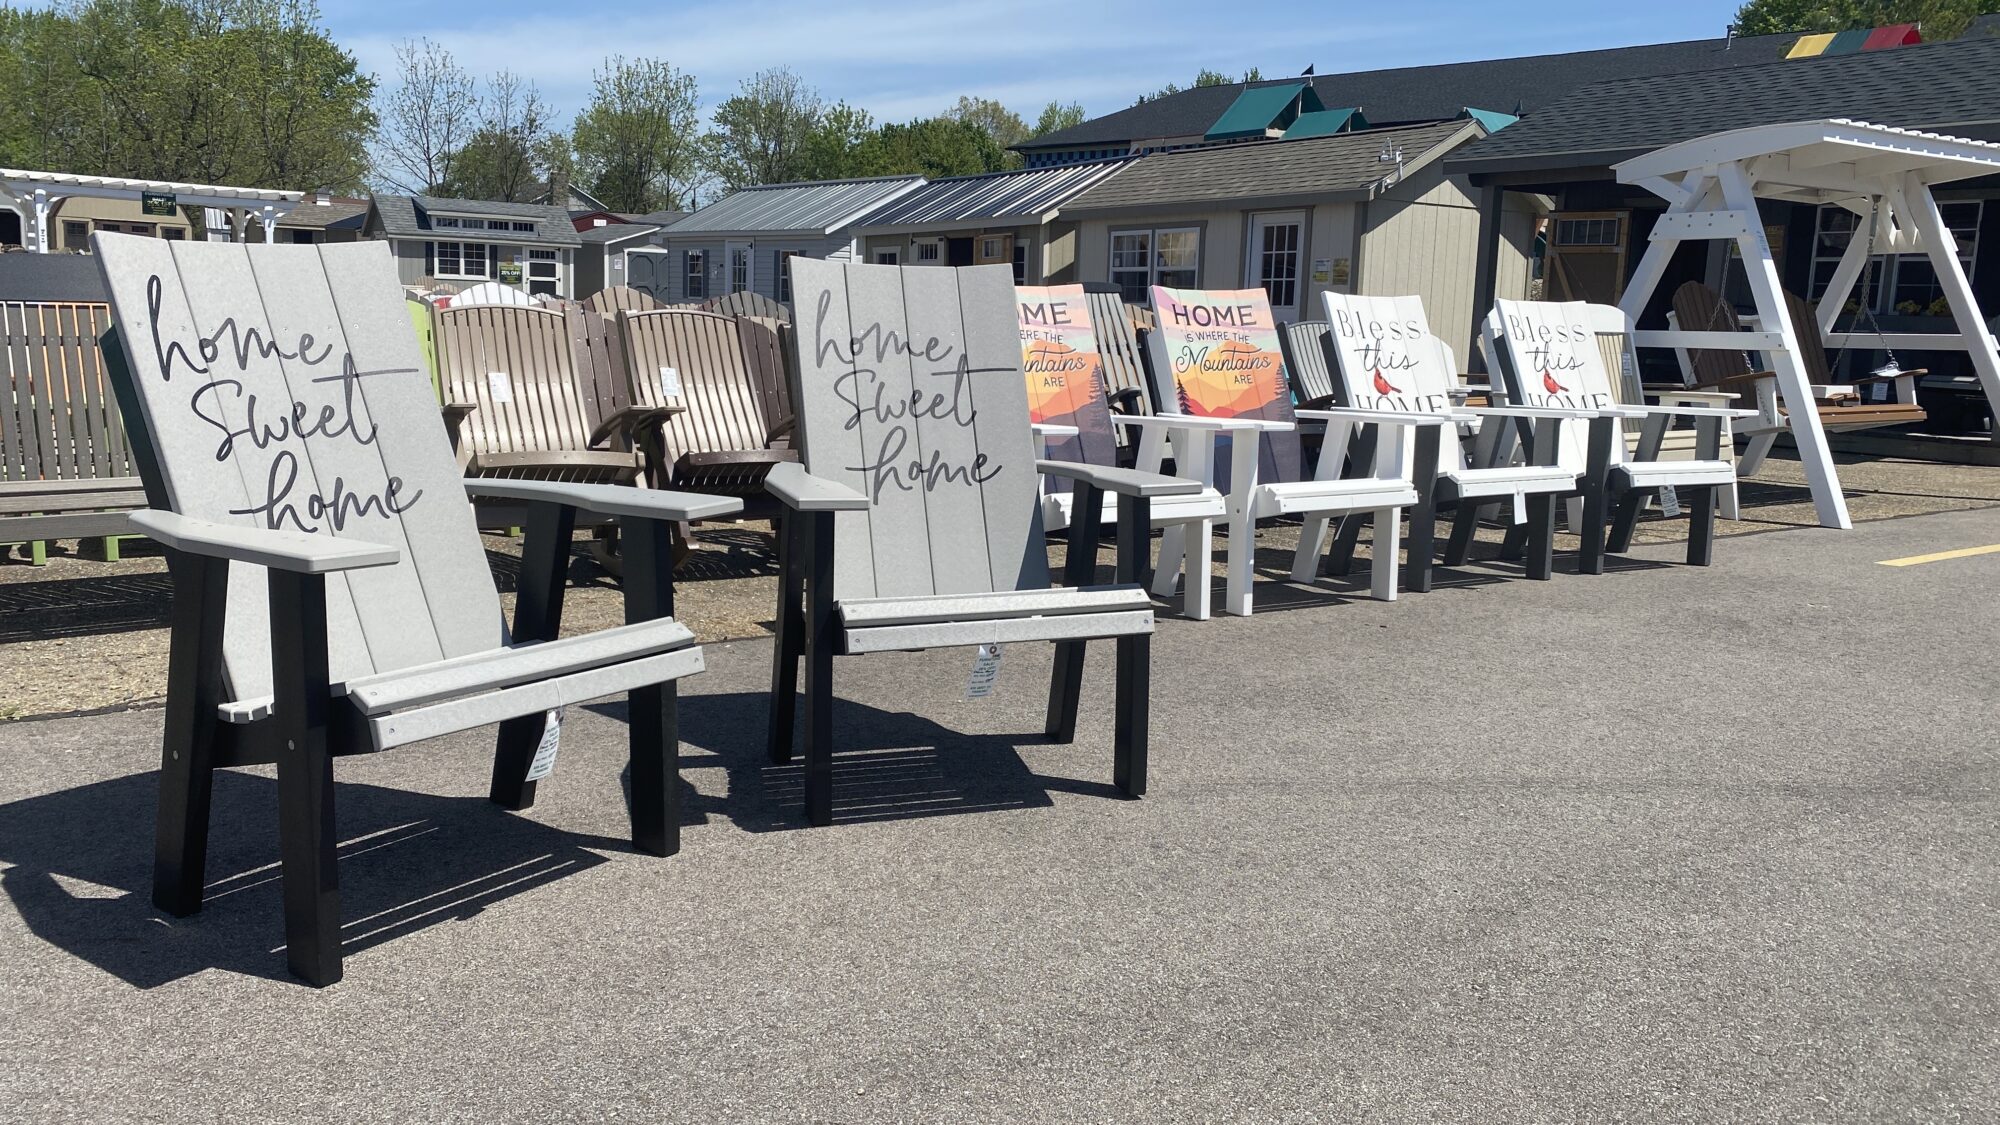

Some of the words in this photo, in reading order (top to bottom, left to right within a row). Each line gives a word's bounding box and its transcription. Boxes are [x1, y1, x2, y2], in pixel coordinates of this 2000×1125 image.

[147, 274, 332, 382] home
[816, 289, 953, 368] home
[1017, 302, 1072, 326] ME
[1171, 303, 1257, 327] HOME
[1336, 309, 1422, 341] Bless
[1508, 314, 1587, 344] Bless
[1019, 329, 1040, 341] ERE
[1043, 331, 1065, 345] THE
[1184, 333, 1194, 343] IS
[1195, 331, 1230, 341] WHERE
[1232, 332, 1251, 345] THE
[1023, 345, 1087, 373] ntains
[1175, 345, 1272, 375] Mountains
[1353, 338, 1419, 371] this
[1525, 341, 1585, 373] this
[1043, 376, 1066, 388] ARE
[1233, 374, 1254, 385] ARE
[845, 426, 1003, 506] home
[229, 450, 423, 533] home
